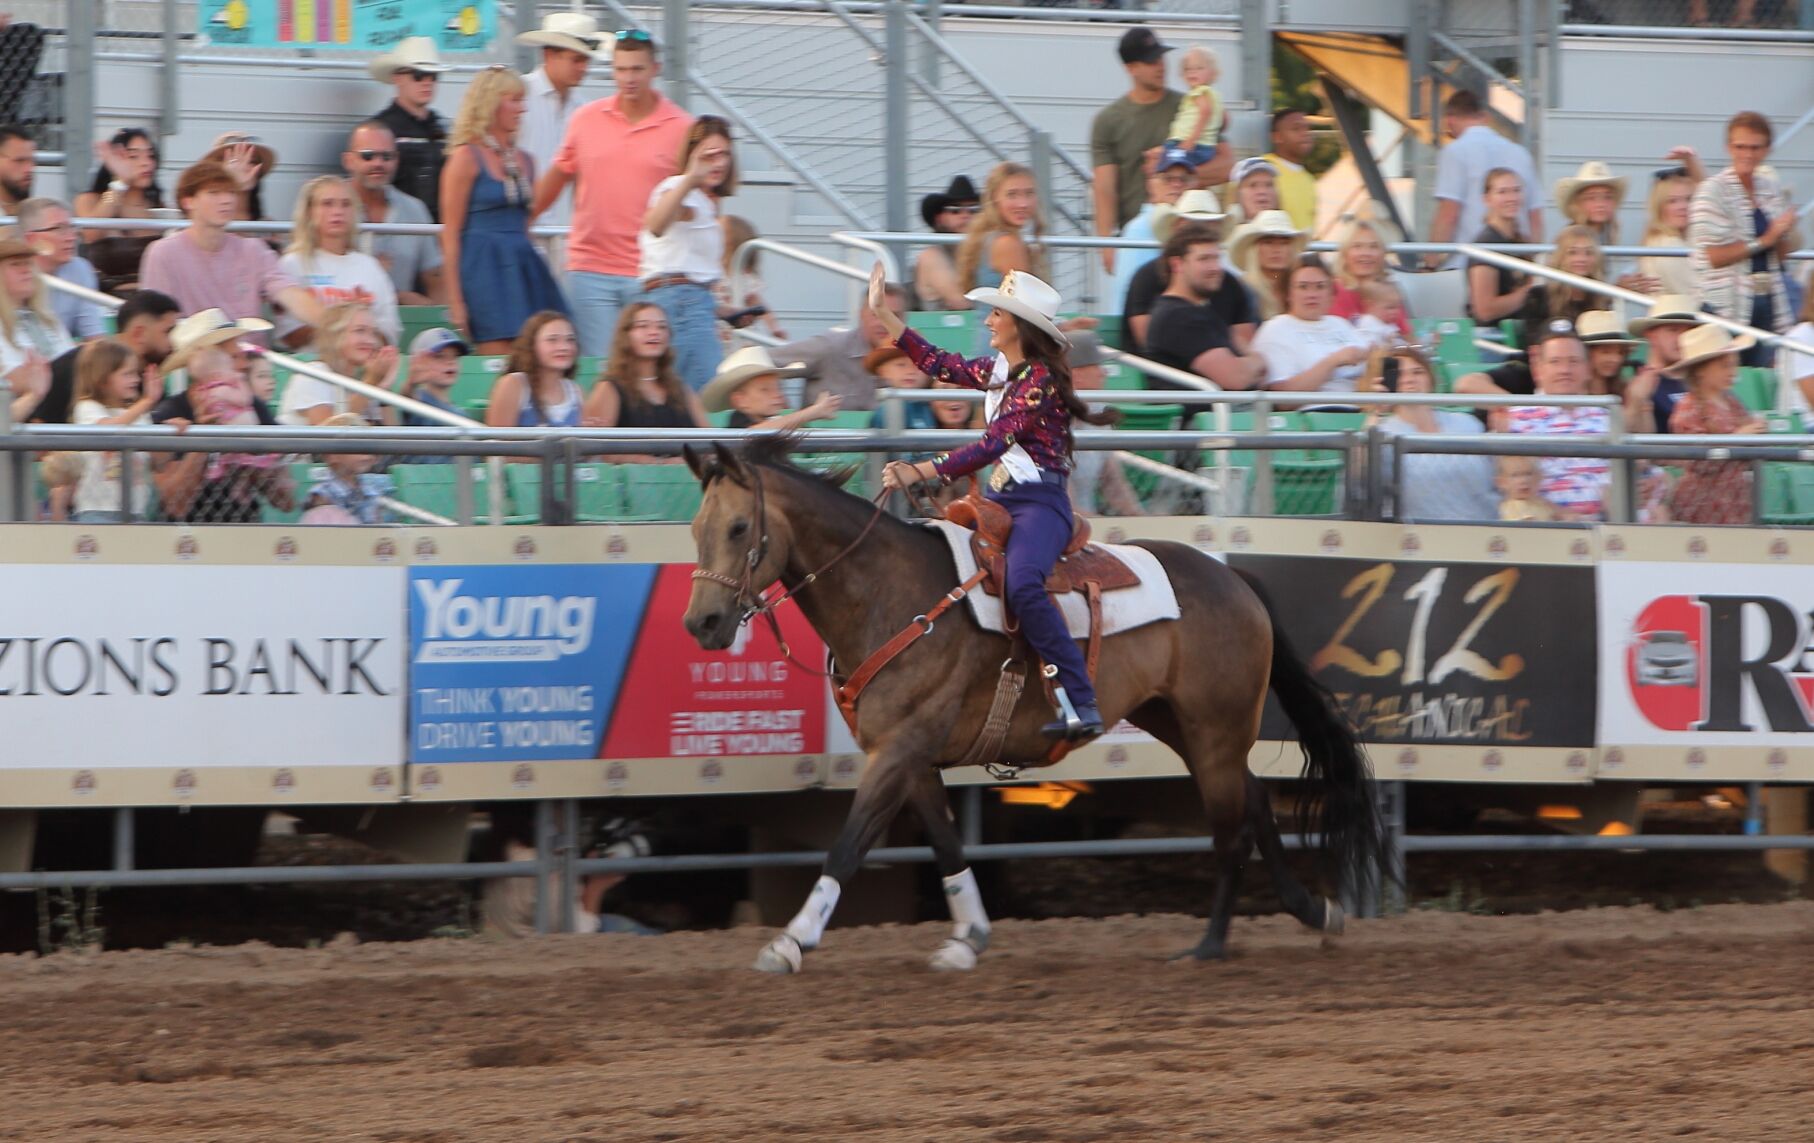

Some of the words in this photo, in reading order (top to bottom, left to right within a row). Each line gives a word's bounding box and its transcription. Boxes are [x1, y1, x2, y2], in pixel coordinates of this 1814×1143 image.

[413, 578, 598, 655] Young
[1309, 562, 1525, 686] 212
[200, 636, 392, 696] BANK
[688, 661, 788, 683] YOUNG
[416, 687, 496, 715] THINK
[498, 684, 594, 713] YOUNG
[418, 722, 497, 750] DRIVE
[498, 719, 594, 748] YOUNG
[747, 709, 806, 731] FAST
[670, 734, 723, 756] LIVE
[723, 731, 805, 754] YOUNG
